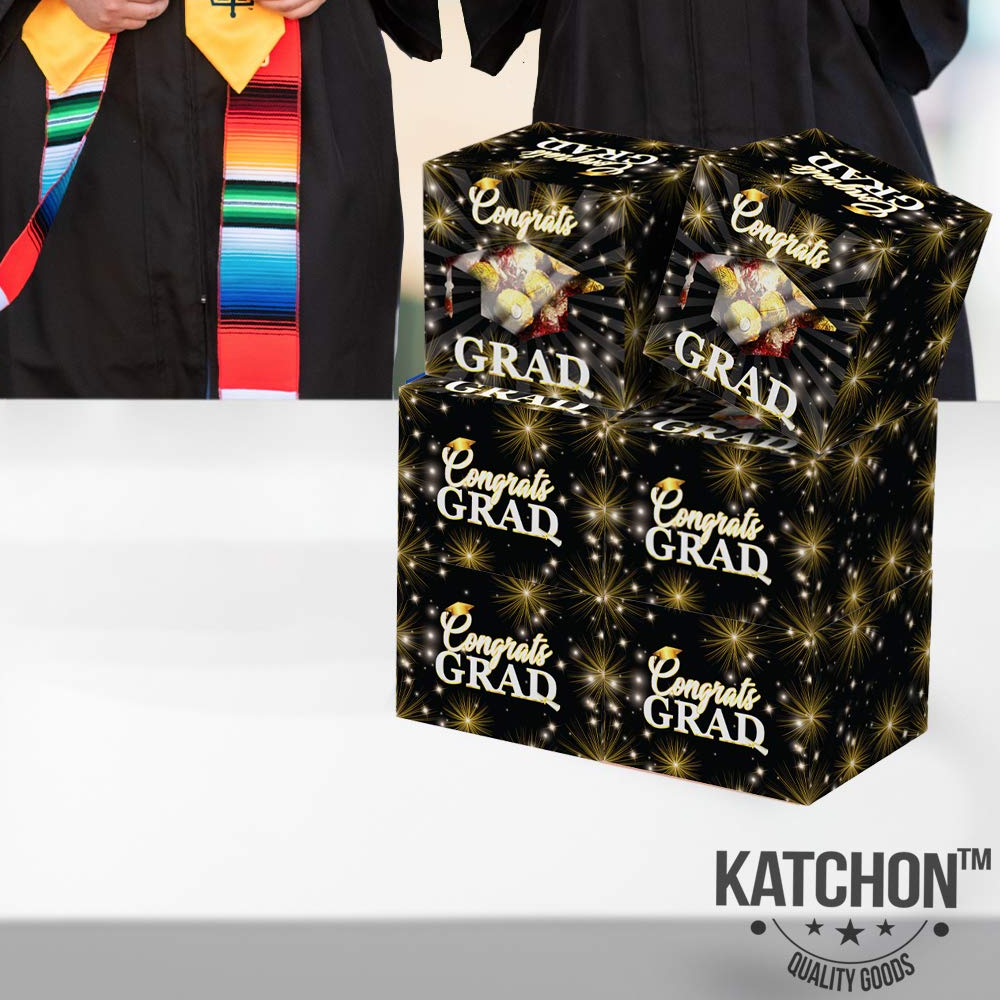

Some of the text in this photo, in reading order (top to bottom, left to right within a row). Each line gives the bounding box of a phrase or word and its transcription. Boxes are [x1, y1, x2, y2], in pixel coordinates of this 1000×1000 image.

[536, 137, 658, 165] GRAD
[808, 151, 924, 211] GRAD
[469, 185, 578, 244] Congrats
[732, 195, 830, 270] Congrats
[453, 335, 595, 400] GRAD
[674, 330, 796, 432] GRAD
[652, 418, 799, 454] GRAD
[442, 445, 554, 505] Congrats
[436, 486, 562, 547] GRAD
[650, 485, 764, 544] Congrats
[645, 527, 772, 586] GRAD
[440, 609, 553, 670] Congrats
[435, 651, 561, 712] GRAD
[648, 654, 761, 714] Congrats
[642, 695, 769, 756] GRAD
